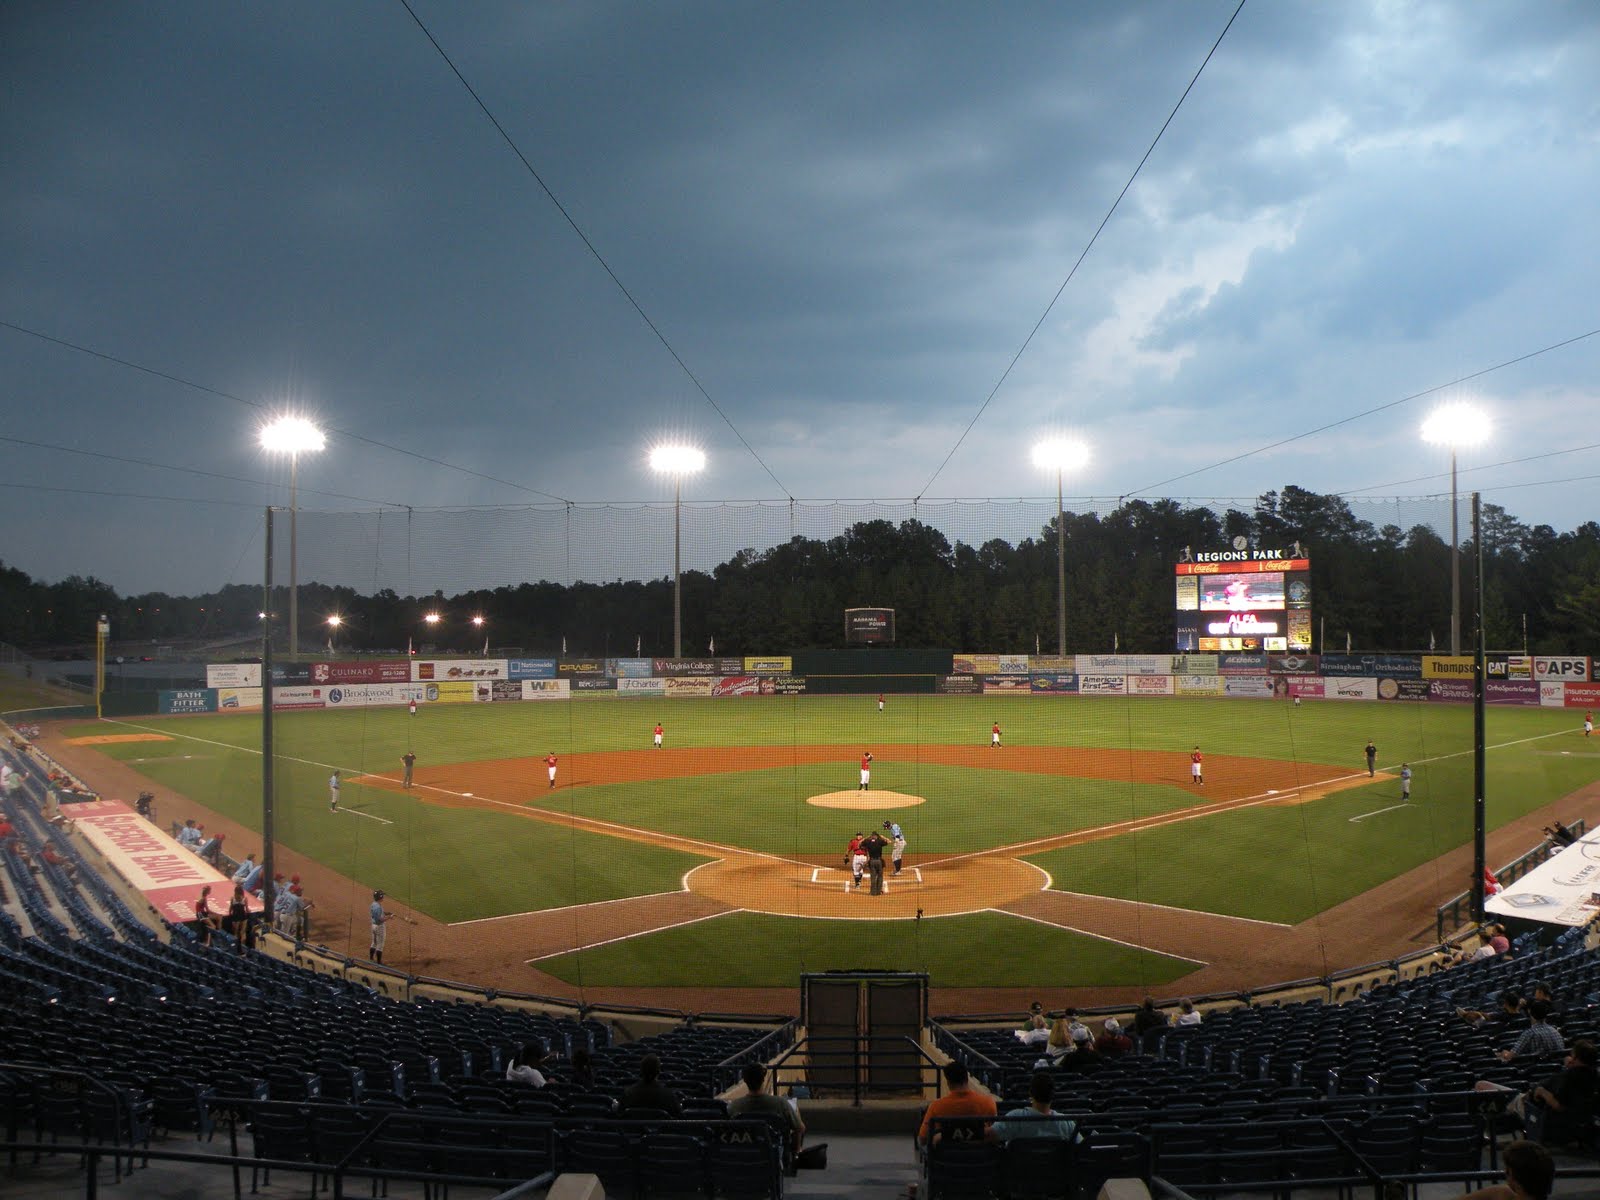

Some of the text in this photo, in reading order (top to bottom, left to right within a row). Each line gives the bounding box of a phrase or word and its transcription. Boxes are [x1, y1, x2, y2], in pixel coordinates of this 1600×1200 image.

[1197, 549, 1283, 562] REGIONS PARK
[331, 667, 374, 676] CULINARD
[665, 661, 715, 672] Virginia College
[1320, 663, 1362, 671] Birmingham
[1432, 661, 1475, 674] Thompso
[1487, 662, 1508, 674] CAT
[1548, 661, 1585, 675] APS
[632, 680, 660, 688] Charter
[712, 677, 759, 696] Budweiser
[1486, 684, 1518, 693] OrthoSports
[343, 687, 394, 697] Brookwood
[173, 699, 205, 707] FITTER
[83, 815, 205, 884] SUPERIOR BANK
